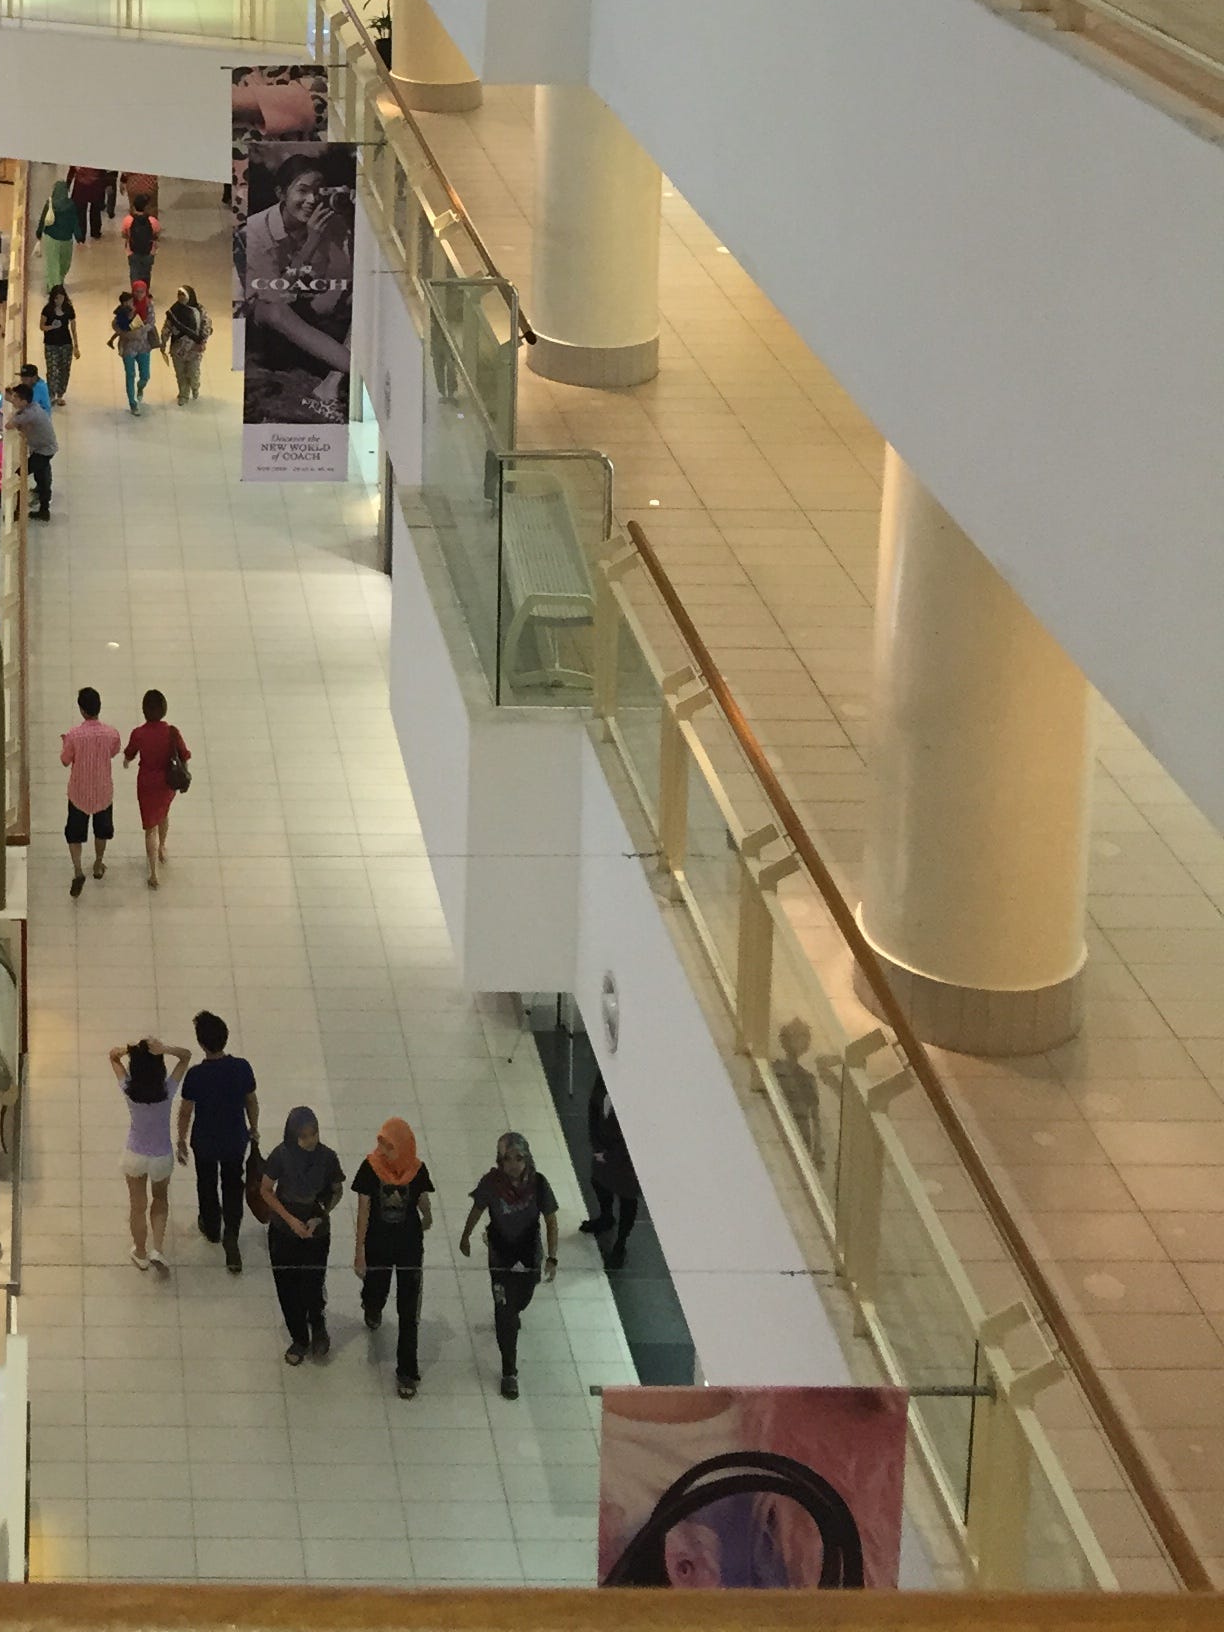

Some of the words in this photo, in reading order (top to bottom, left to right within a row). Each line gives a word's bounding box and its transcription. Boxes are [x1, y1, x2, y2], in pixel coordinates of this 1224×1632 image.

[251, 278, 347, 291] COACH
[260, 444, 287, 452] NEW
[289, 443, 331, 452] WORLD
[282, 452, 321, 461] COACH
